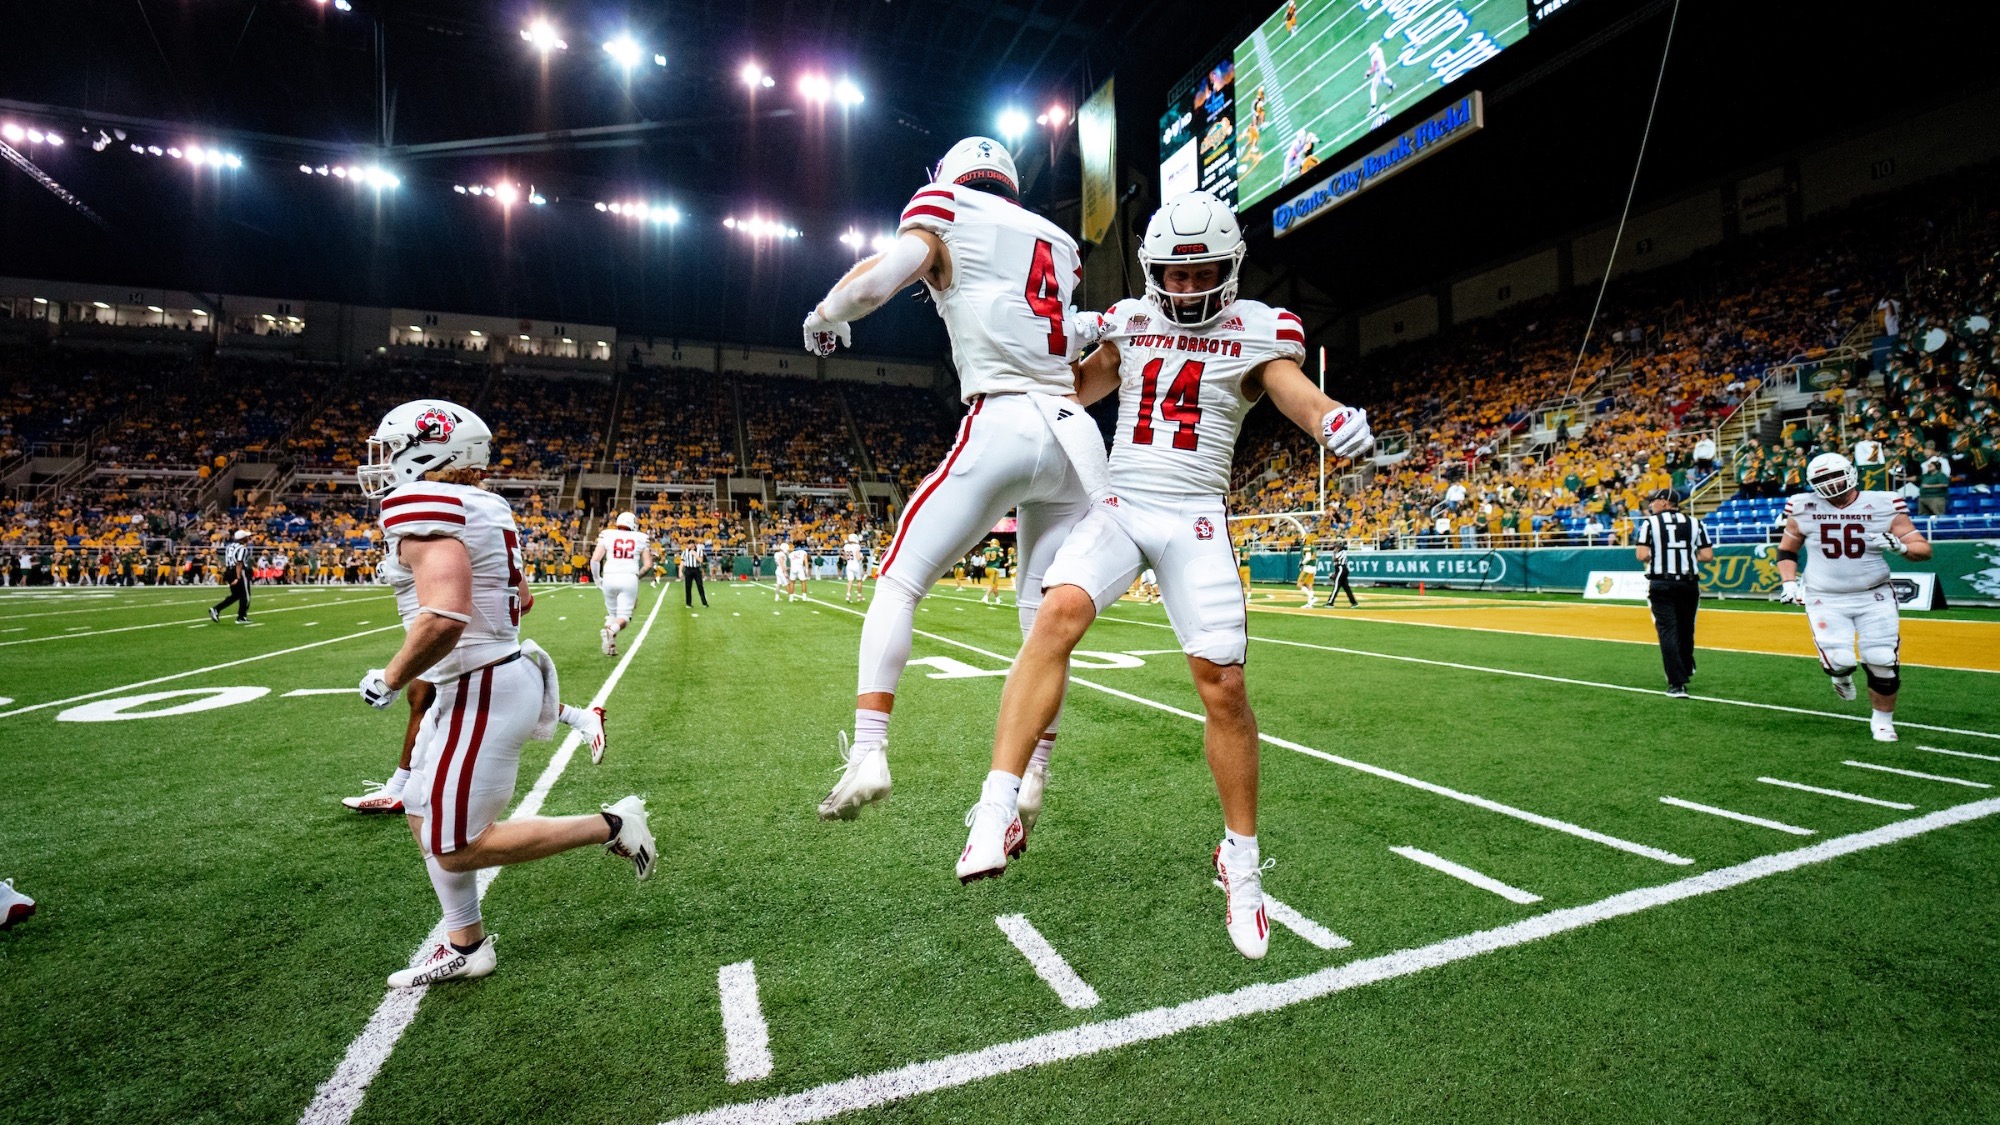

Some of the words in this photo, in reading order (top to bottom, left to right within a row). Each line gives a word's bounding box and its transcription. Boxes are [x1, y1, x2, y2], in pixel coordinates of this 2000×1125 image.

[1293, 189, 1329, 218] Gate
[1328, 167, 1362, 196] City
[1363, 135, 1412, 179] Bank
[1415, 98, 1471, 149] Field
[1873, 160, 1892, 178] 10
[955, 170, 984, 185] SOUTH
[1176, 244, 1204, 253] YOTES
[1025, 238, 1068, 357] 4
[1222, 324, 1246, 332] adidas
[1129, 334, 1175, 350] SOUTH
[1177, 335, 1242, 358] DAKOTA
[1132, 357, 1206, 451] 14
[1840, 513, 1873, 521] DAKOTA
[1665, 524, 1687, 548] L
[1820, 523, 1866, 560] 56
[613, 538, 636, 559] 62
[1347, 560, 1379, 573] CITY
[1386, 559, 1430, 573] BANK
[1437, 559, 1490, 573] FIELD
[411, 955, 467, 987] ADIZERO
